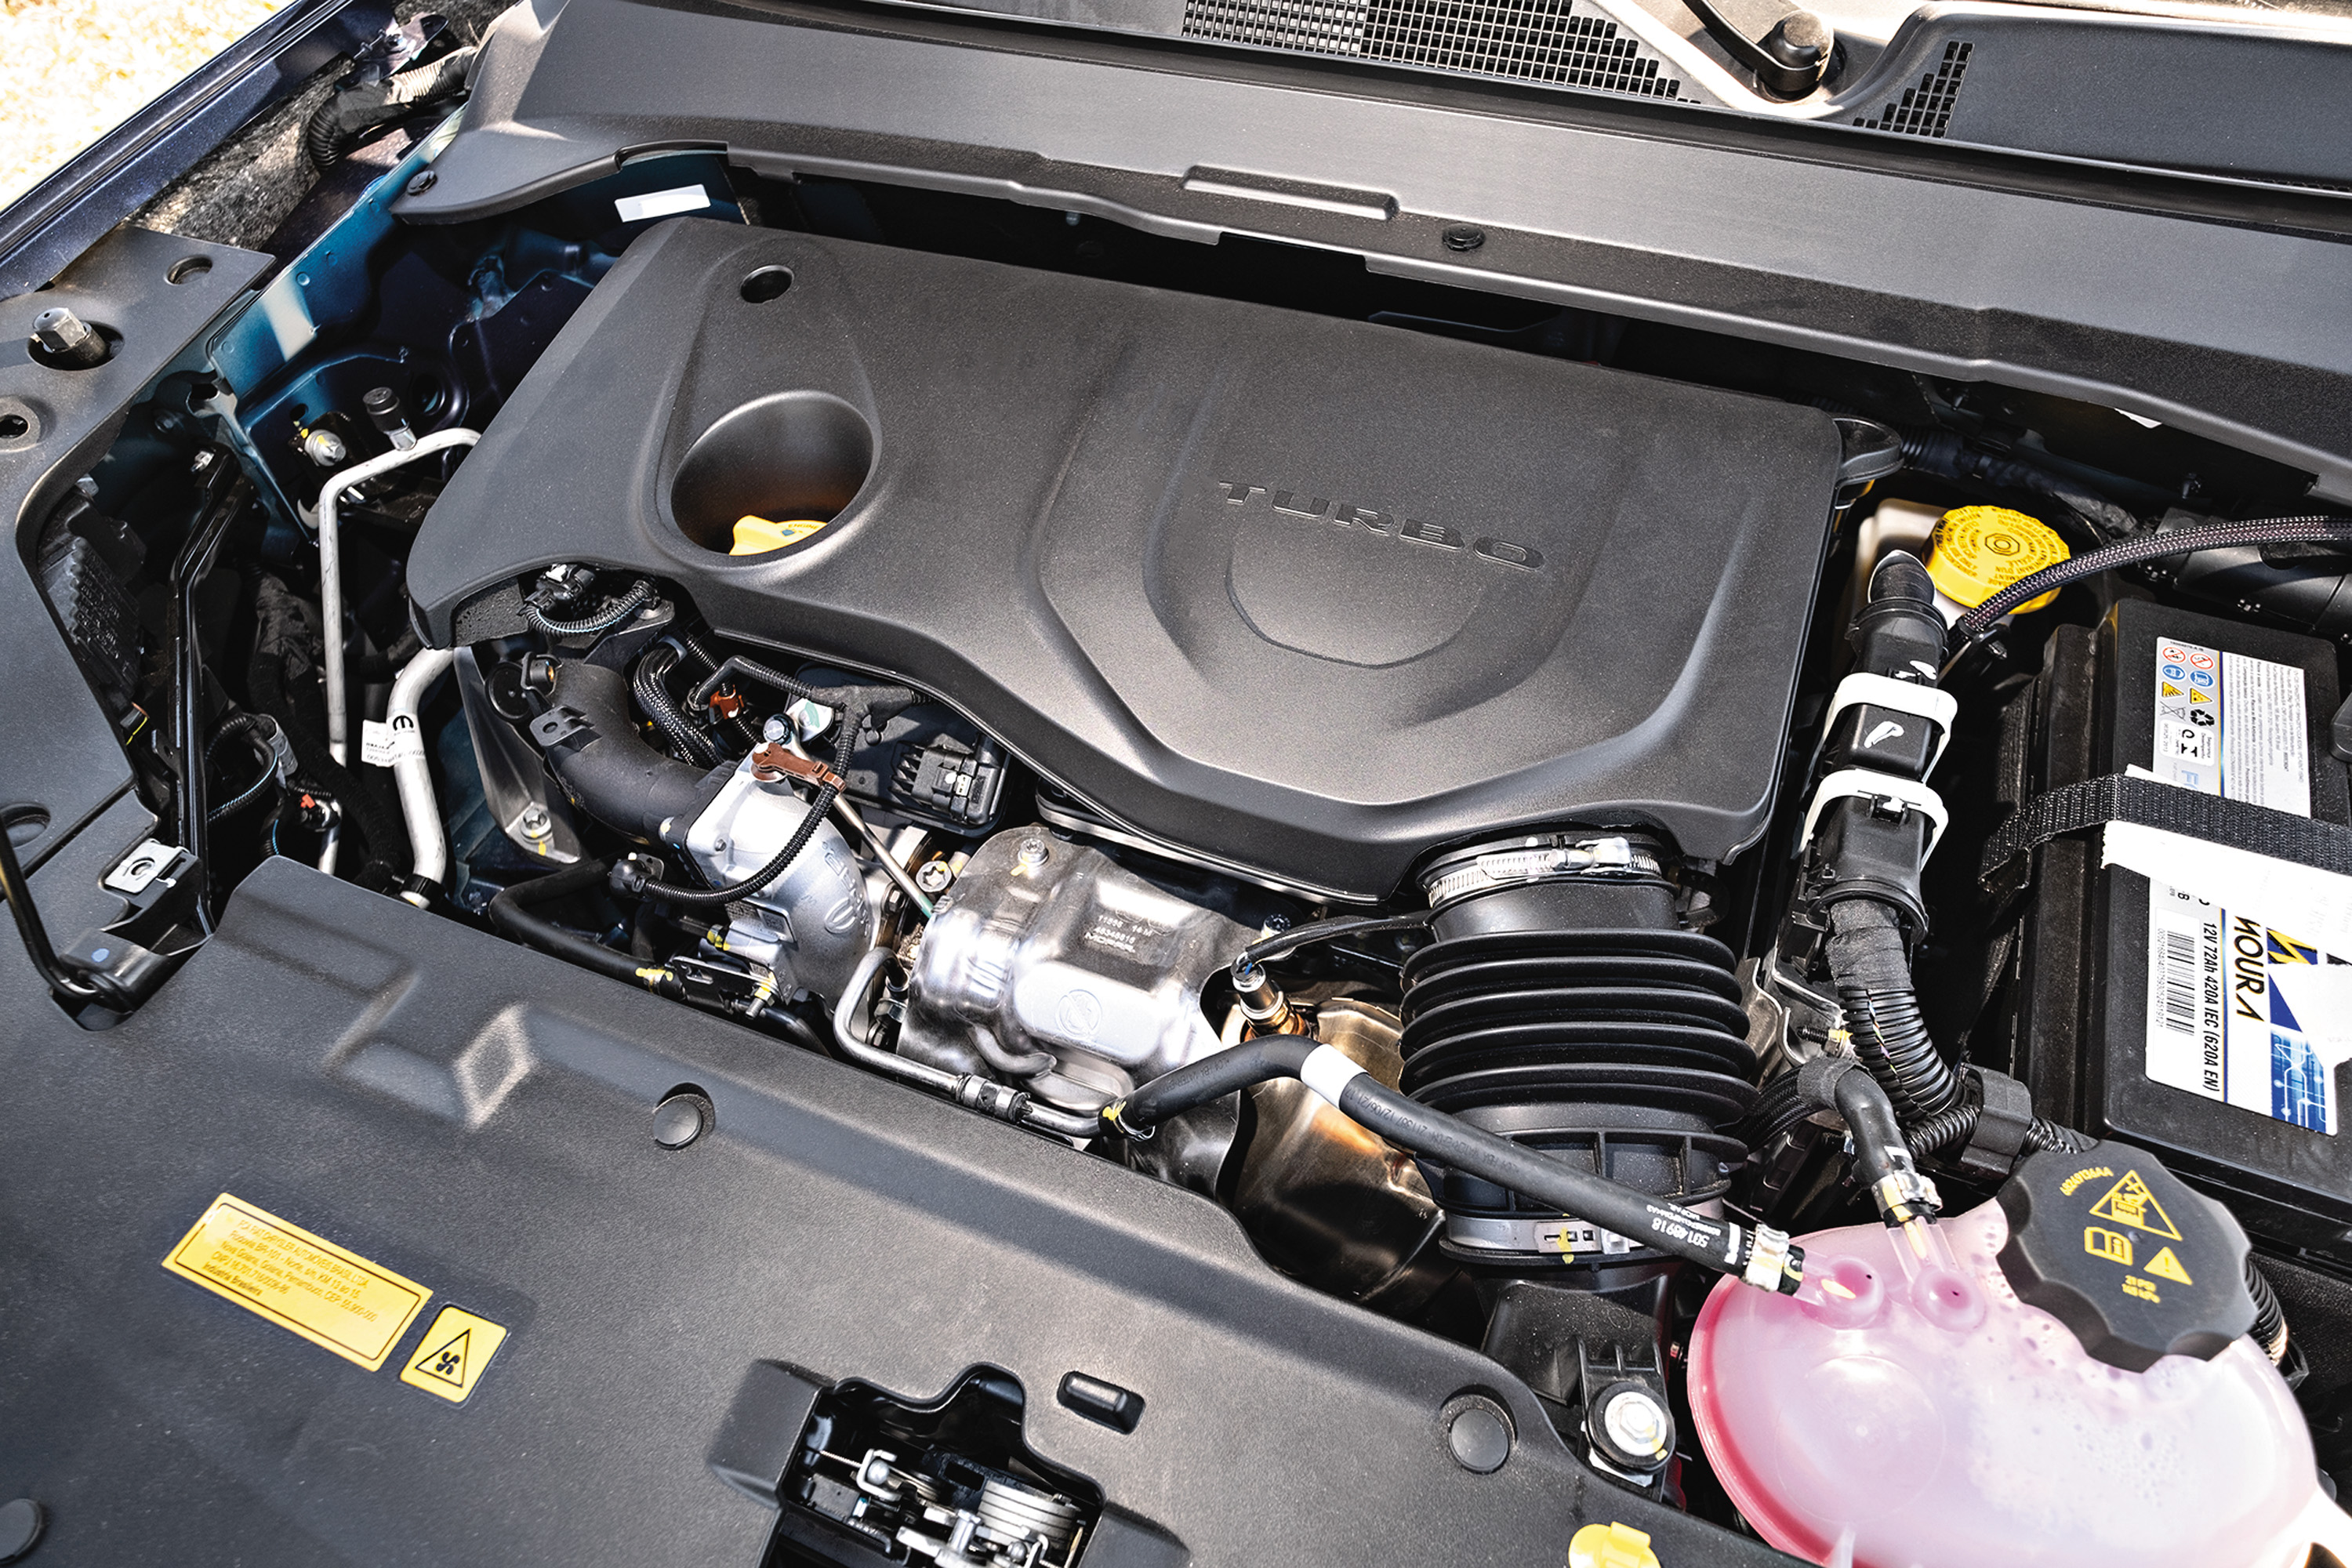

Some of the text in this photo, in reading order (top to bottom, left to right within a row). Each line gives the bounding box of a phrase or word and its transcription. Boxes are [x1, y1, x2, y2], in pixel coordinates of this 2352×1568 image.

[1219, 481, 1545, 571] TURBO
[2202, 920, 2220, 1093] 12V 72Ah 420A IEC (620A EN)
[220, 1240, 239, 1254] Nova
[1651, 1218, 1710, 1249] 50148918
[254, 1243, 281, 1260] BR-101
[328, 1279, 342, 1289] 13
[230, 1275, 264, 1296] Brasileira
[2139, 1278, 2157, 1292] PSI
